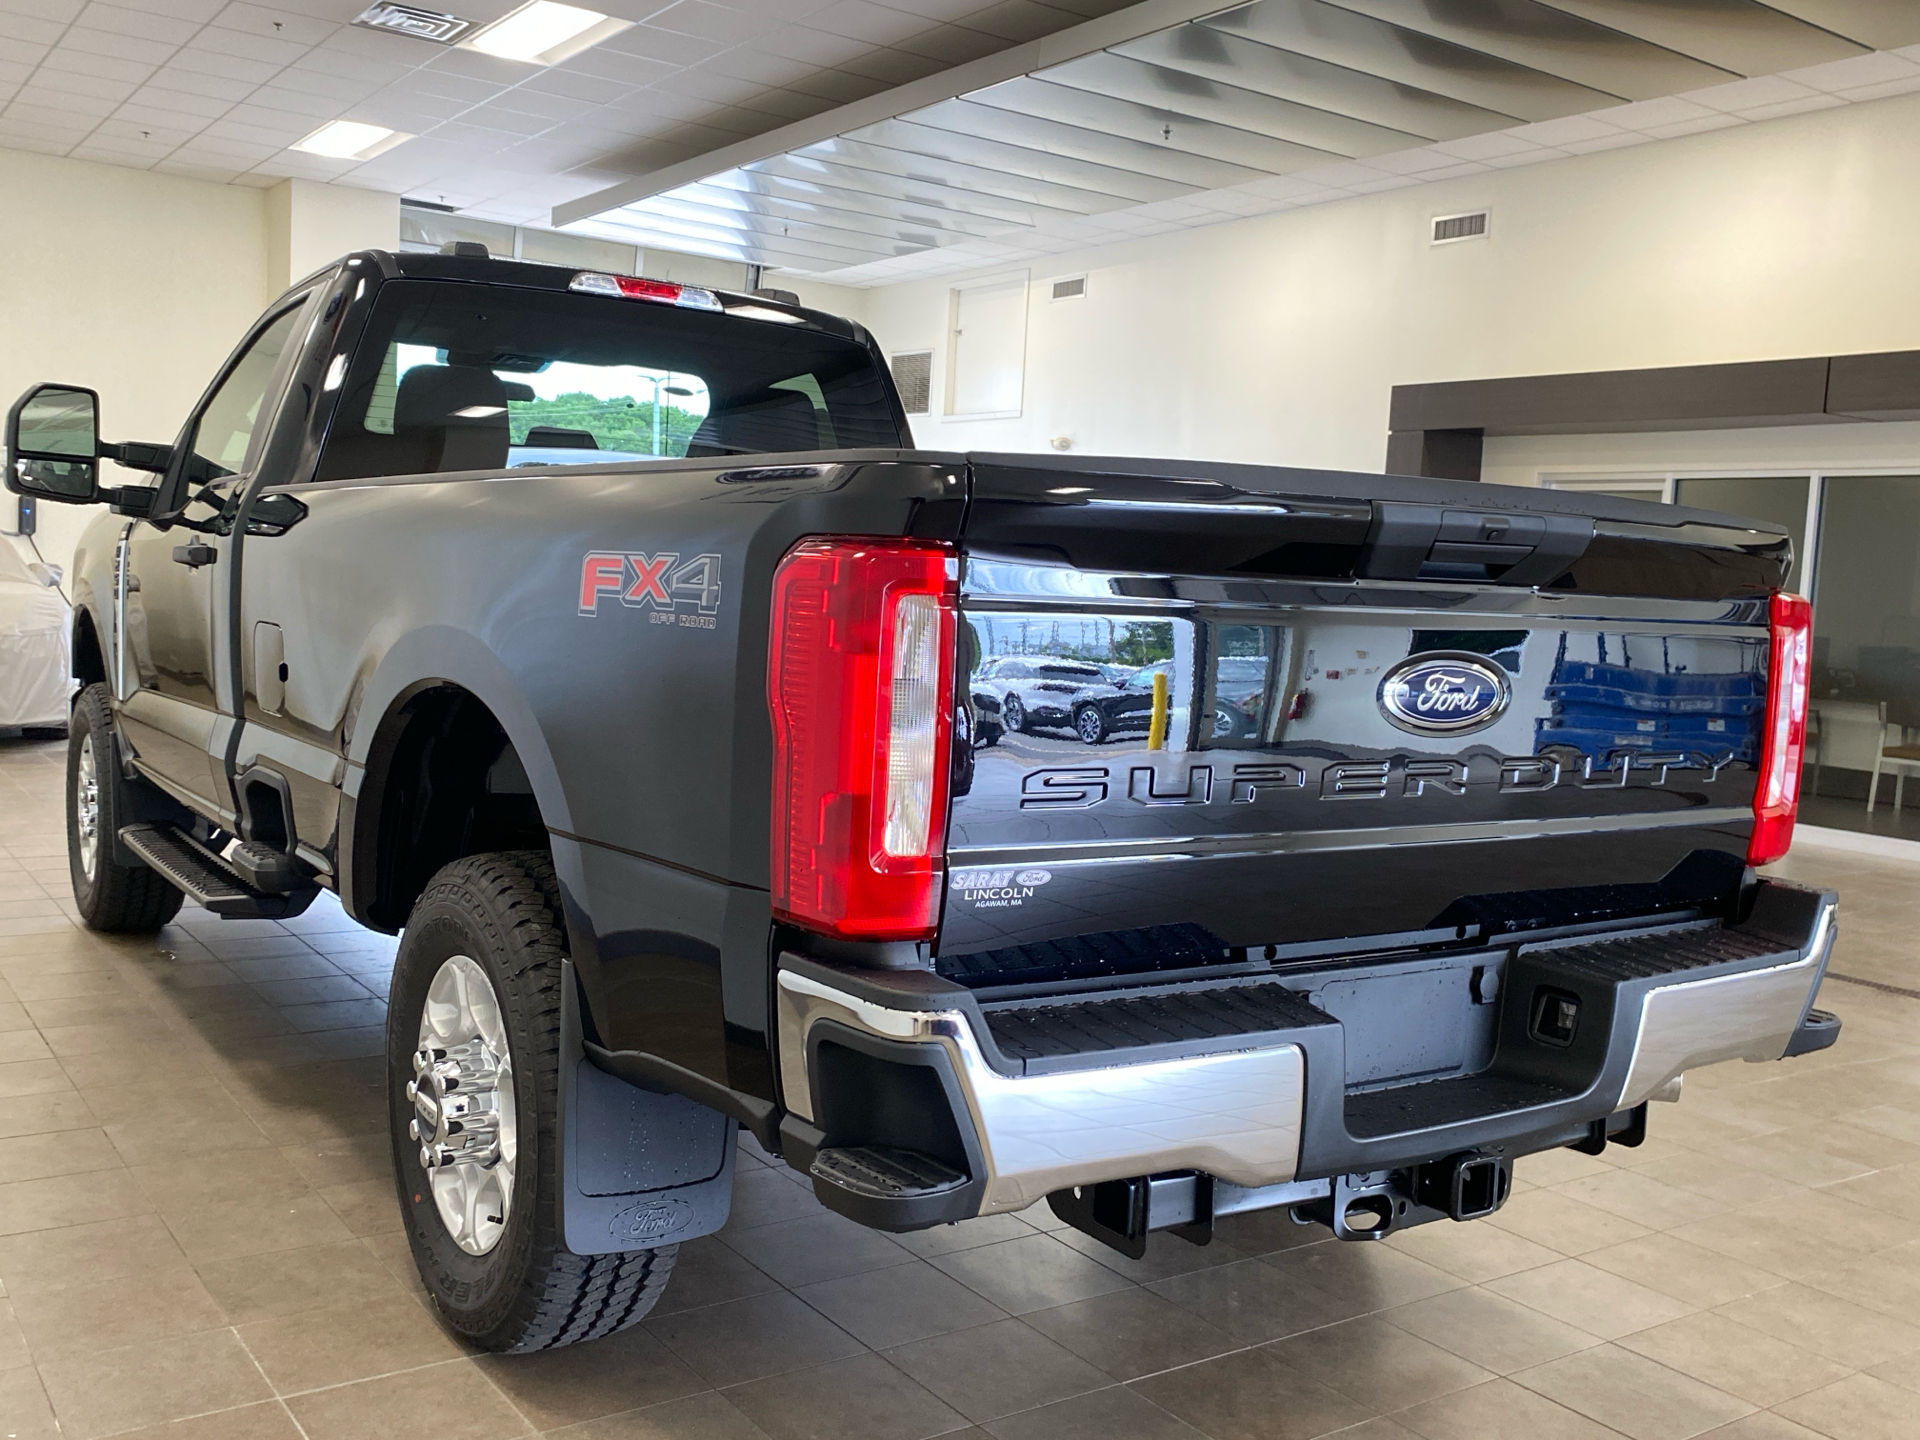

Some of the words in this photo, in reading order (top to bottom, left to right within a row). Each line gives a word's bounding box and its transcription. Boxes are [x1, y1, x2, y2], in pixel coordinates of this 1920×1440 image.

[578, 550, 721, 617] FX4
[649, 612, 676, 625] OFF
[679, 614, 716, 629] ROAD
[1417, 671, 1480, 711] Ford
[1019, 760, 1469, 811] SUPER
[1500, 751, 1735, 794] DUTY
[950, 870, 1015, 890] SARAT
[964, 886, 1034, 900] LINCOLN
[975, 899, 1009, 909] AGAWAM,
[1010, 898, 1022, 907] MA
[628, 1206, 677, 1235] Ford
